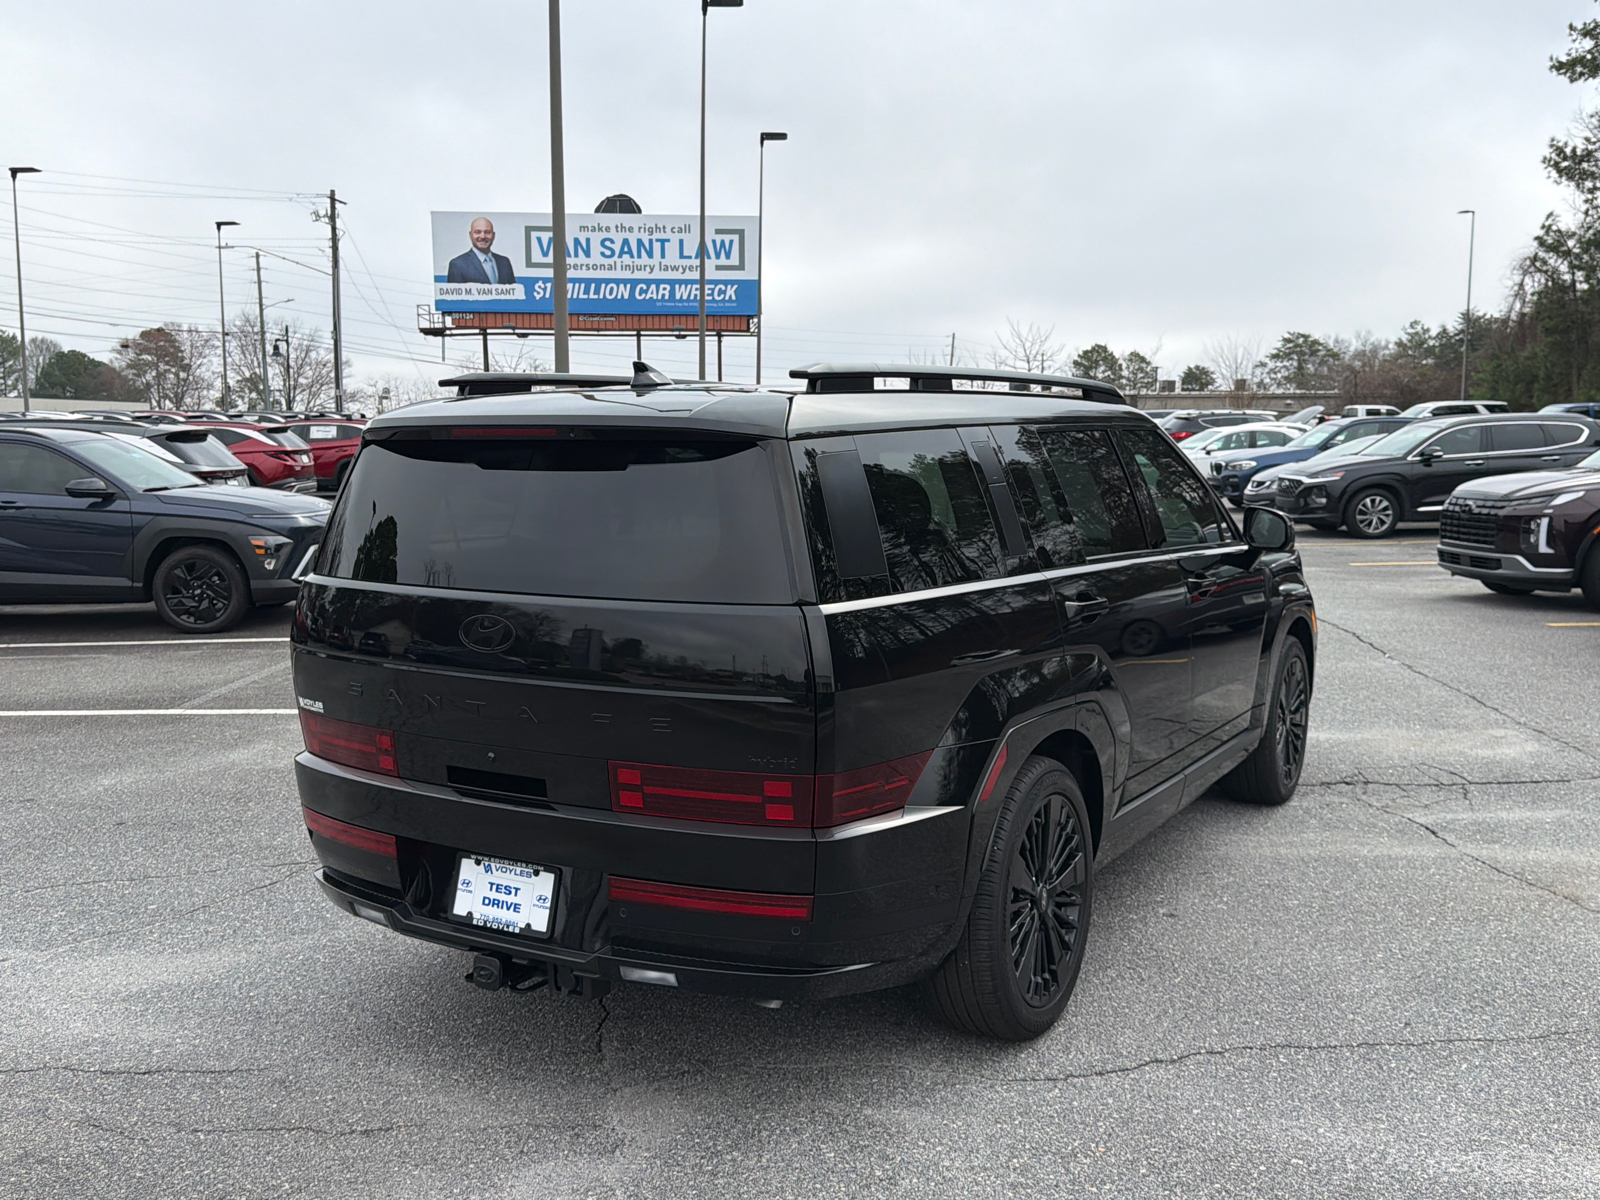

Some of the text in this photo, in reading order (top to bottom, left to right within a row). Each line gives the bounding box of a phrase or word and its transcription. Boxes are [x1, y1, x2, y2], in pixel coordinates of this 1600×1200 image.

[579, 223, 691, 236] make the right call
[599, 237, 671, 259] SANT
[679, 238, 734, 260] LAW
[620, 261, 655, 274] injury
[439, 287, 516, 296] DAVID M. VAN SANT
[533, 280, 553, 300] $1
[635, 283, 671, 300] CAR
[674, 284, 738, 300] WRECK
[494, 864, 533, 879] VOYLES
[488, 881, 521, 897] TEST
[481, 896, 522, 914] DRIVE
[472, 918, 520, 933] ED VOYLES
